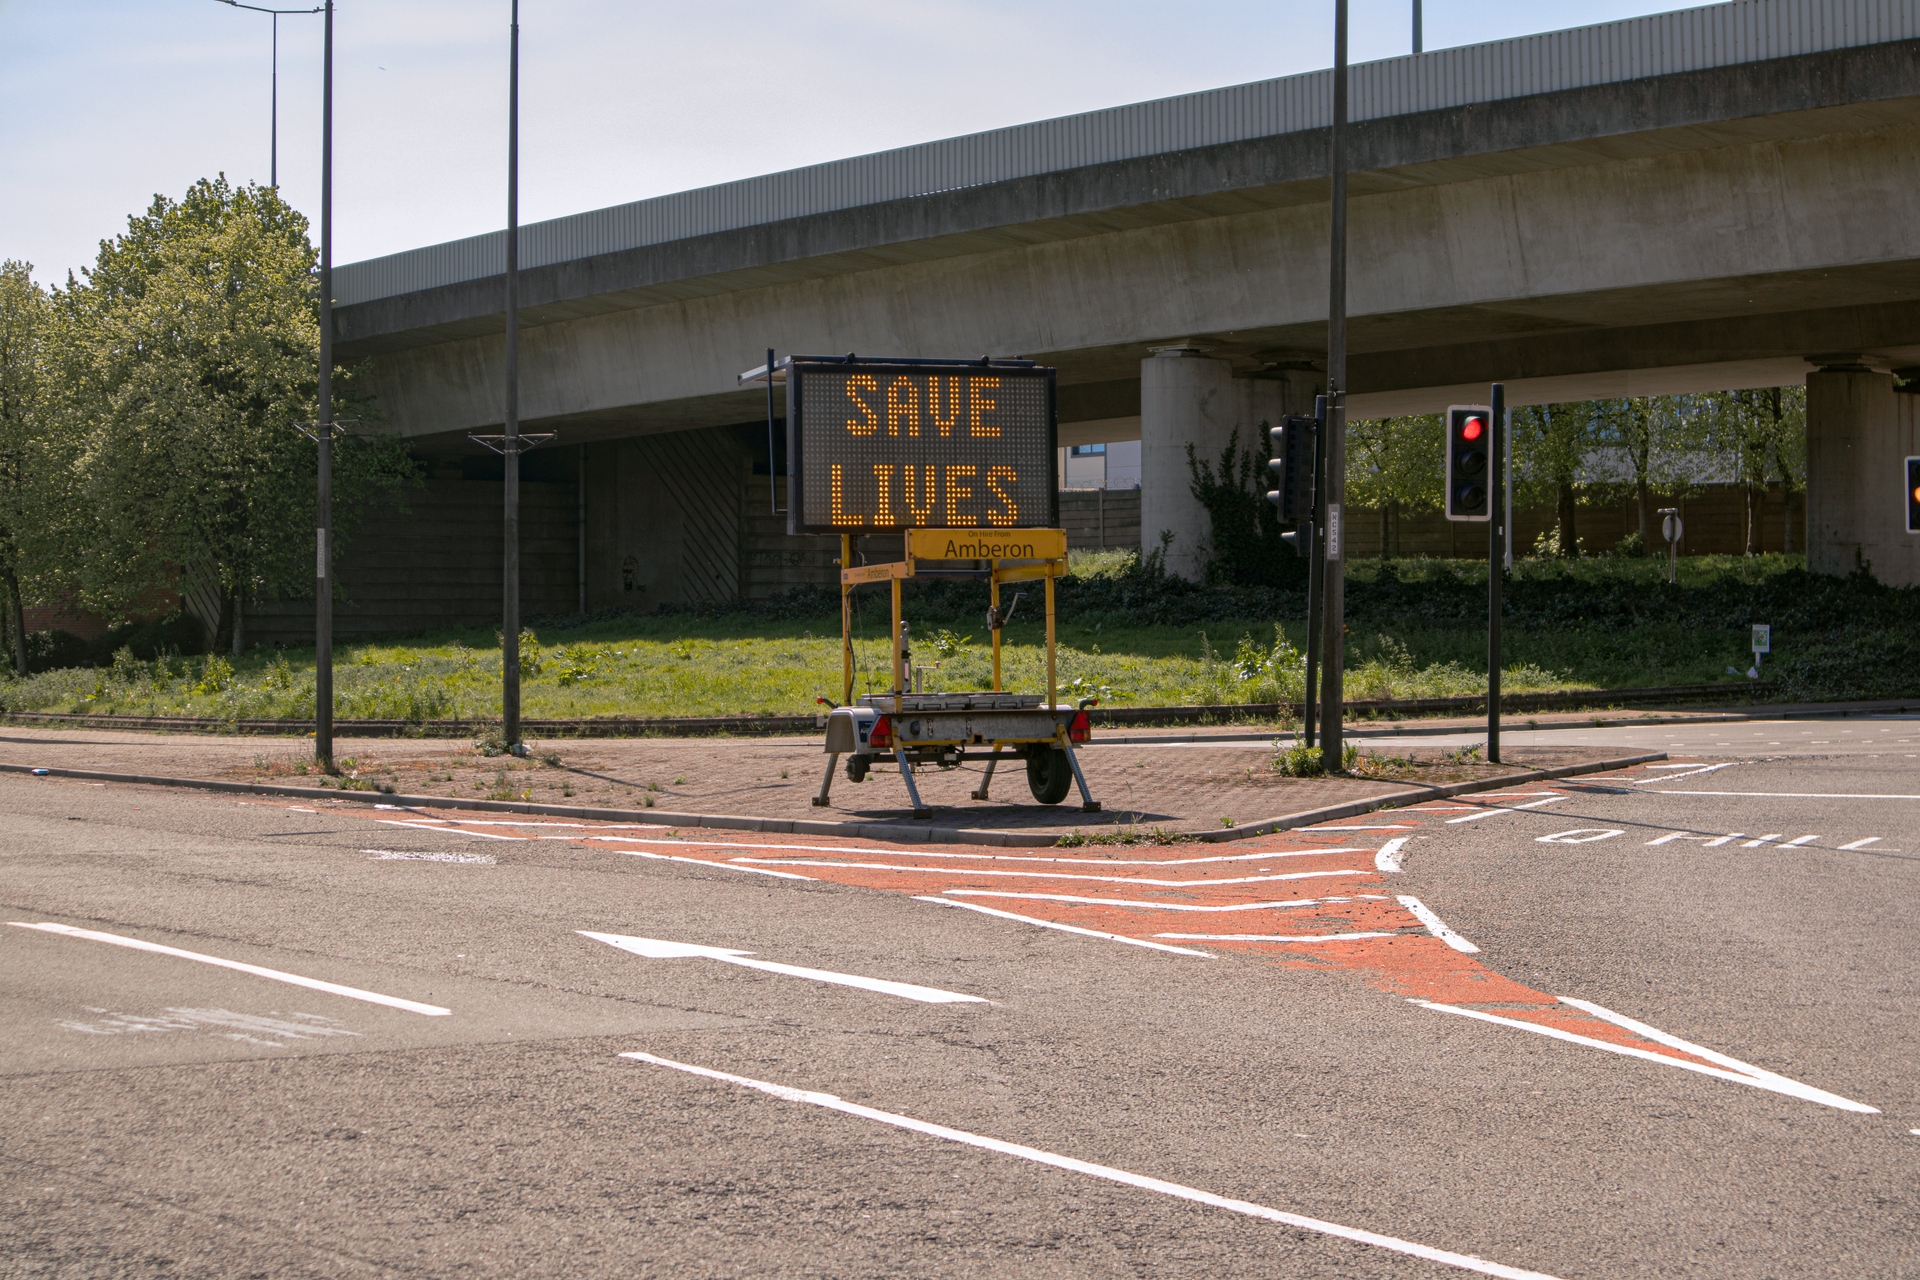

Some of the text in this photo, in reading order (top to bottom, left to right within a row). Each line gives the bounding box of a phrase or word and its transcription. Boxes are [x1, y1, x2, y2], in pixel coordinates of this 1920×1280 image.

[846, 374, 1001, 437] SAVE
[831, 464, 1018, 526] LIVES
[968, 530, 1011, 538] On Hire From
[944, 539, 1034, 558] Amberon
[1643, 832, 1901, 851] HILL
